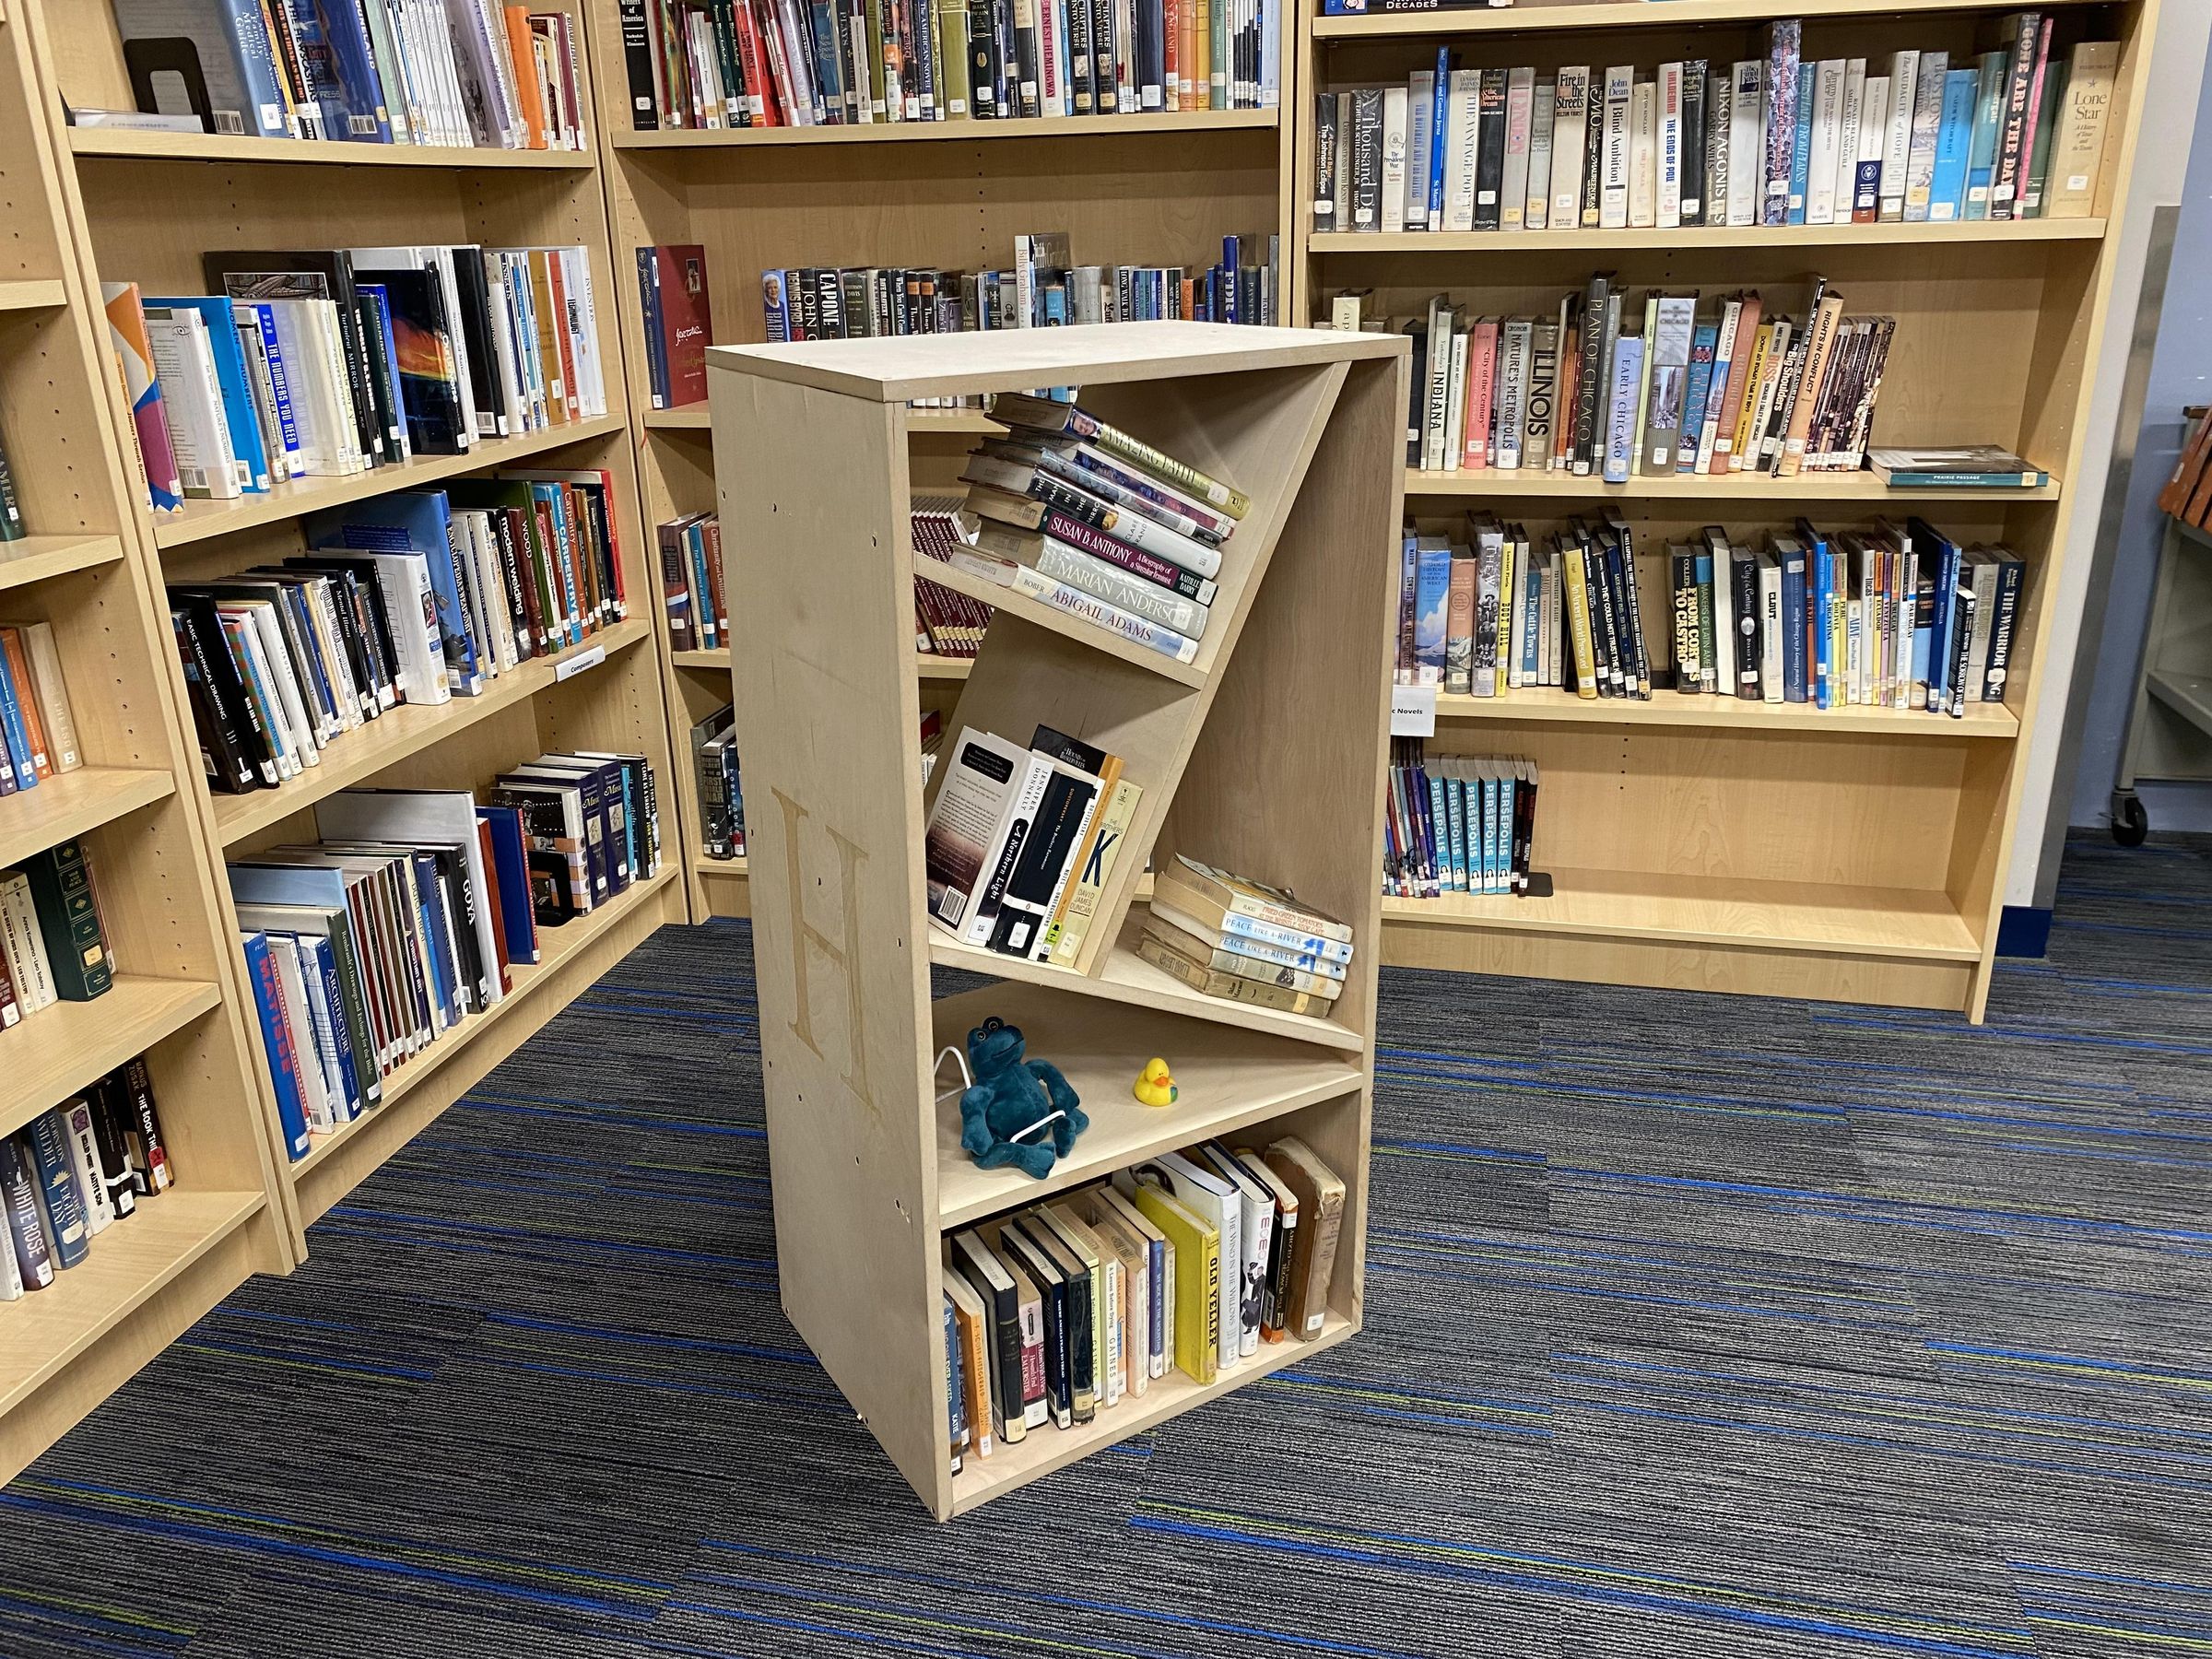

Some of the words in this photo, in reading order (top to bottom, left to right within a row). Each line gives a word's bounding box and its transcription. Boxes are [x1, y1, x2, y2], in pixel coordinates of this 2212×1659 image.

[235, 17, 248, 54] Guide
[242, 11, 258, 60] Medical
[921, 16, 930, 61] AMERICAN
[2016, 27, 2034, 74] GONE
[923, 63, 931, 92] NOVEL
[1043, 45, 1055, 98] HEMINGWAY
[1559, 74, 1577, 87] Fire
[1577, 73, 1585, 85] in
[1609, 79, 1628, 89] John
[1556, 96, 1584, 109] Streets
[1571, 85, 1583, 97] the
[1608, 88, 1629, 97] Dean
[1718, 80, 1731, 132] NIXON
[1898, 70, 1910, 118] AUDACITY
[2011, 77, 2028, 112] ARE
[2074, 92, 2108, 105] Lone
[1612, 107, 1624, 134] Blind
[1896, 122, 1904, 130] of
[2075, 106, 2101, 121] Star
[1360, 113, 1380, 186] Thousand
[1894, 132, 1903, 159] HOPE
[2006, 117, 2021, 154] THE
[1320, 140, 1328, 169] Johnson
[1610, 135, 1622, 182] Ambition
[1707, 143, 1715, 170] WILLS
[1714, 137, 1728, 224] AGONISS
[1018, 249, 1028, 269] Billy
[501, 262, 512, 300] INSECTS
[819, 273, 839, 325] CAPONE
[896, 276, 904, 293] When
[1018, 269, 1028, 306] Graham
[801, 289, 817, 327] JOHN
[897, 304, 905, 318] Can't
[1587, 300, 1603, 339] PLAN
[1818, 311, 1832, 342] RIGHTS
[227, 306, 240, 345] WOMEN
[239, 363, 254, 411] NUMBERS
[266, 343, 279, 358] THE
[340, 312, 352, 349] Turbulent
[348, 353, 359, 389] MIRROR
[1508, 334, 1522, 382] NATURE'S
[1585, 342, 1599, 365] OF
[1784, 351, 1797, 367] Big
[1816, 342, 1824, 352] IN
[270, 362, 288, 401] NUMBERS
[1619, 359, 1630, 396] EARLY
[1773, 367, 1793, 412] Shoulders
[1806, 353, 1821, 394] CONFLICT
[1430, 371, 1444, 430] INDIANA
[1527, 349, 1556, 436] ILLINOIS
[1579, 367, 1596, 441] CHICAGO
[280, 404, 293, 420] YOU
[1501, 385, 1518, 449] METROPOLIS
[1613, 402, 1626, 458] CHICAGO
[284, 423, 297, 444] NEED
[556, 495, 564, 524] MODERN
[563, 492, 576, 545] Carpentry
[522, 520, 533, 559] WOOD
[1051, 517, 1080, 542] SUSAN
[1082, 531, 1090, 547] B.
[1090, 535, 1133, 563] ANTHONY
[501, 516, 516, 567] modern
[509, 567, 524, 616] welding
[559, 525, 577, 610] CARPENTRY
[1057, 561, 1114, 597] MARIAN
[1116, 588, 1193, 627] ANDERSO
[1529, 596, 1537, 612] The
[1601, 586, 1609, 602] THEY
[1676, 588, 1688, 608] TO
[1768, 592, 1776, 619] CLOUT
[1865, 578, 1874, 596] Incas
[2004, 591, 2014, 614] THE
[335, 590, 346, 615] Mental
[341, 616, 352, 638] Illness
[1023, 579, 1045, 593] BOBER
[1050, 589, 1103, 621] ABIGAIL
[1106, 615, 1154, 641] ADAMS
[1500, 602, 1510, 623] BOOT
[1527, 612, 1536, 633] Cattle
[1603, 603, 1612, 624] COULD
[1687, 587, 1699, 627] FROM
[1701, 616, 1709, 627] OF
[1500, 627, 1510, 646] HILL
[1526, 634, 1535, 658] Towns
[1608, 636, 1617, 655] TRUST
[1676, 610, 1688, 664] CASTRO
[1701, 627, 1711, 648] LATIN
[1994, 615, 2011, 666] WARRIOR
[185, 618, 200, 641] BASIC
[194, 642, 215, 684] TECHNICAL
[209, 685, 228, 721] DRAWING
[1610, 655, 1618, 667] THE
[1687, 629, 1700, 682] CORTS
[1397, 707, 1423, 715] Novels
[1020, 767, 1041, 811] DONNELLY
[1029, 771, 1049, 811] JENNIFER
[1014, 825, 1022, 837] A
[1432, 782, 1445, 853] PERSEPOLIS
[1449, 784, 1461, 855] PERSEPOLIS
[1466, 786, 1477, 857] PERSEPOLIS
[1486, 785, 1494, 856] PERSEPOLIS
[1500, 784, 1510, 856] PERSEPOLIS
[999, 836, 1021, 875] Northern
[1081, 829, 1119, 888] K
[462, 878, 477, 925] GOYA
[990, 874, 1004, 900] Light
[1074, 897, 1092, 907] JAMES
[1077, 888, 1095, 900] DAVID
[1219, 935, 1245, 949] PEACE
[1247, 945, 1262, 953] LIKE
[1270, 949, 1295, 962] RIVER
[1226, 918, 1253, 932] PEACE
[1254, 928, 1269, 936] LIKE
[1277, 932, 1301, 946] RIVER
[258, 958, 290, 1075] MATISSE
[327, 967, 351, 1055] ARCHITECTURE
[365, 1058, 373, 1076] Bible
[138, 1093, 147, 1111] THE
[47, 1114, 65, 1163] THORNTON
[142, 1110, 154, 1134] BOOK
[37, 1118, 56, 1169] WILDER
[13, 1179, 38, 1219] WHITE
[21, 1219, 45, 1258] ROSE
[1209, 1257, 1218, 1287] OLD
[1230, 1261, 1237, 1270] IN
[1208, 1291, 1218, 1348] YELLER
[1229, 1286, 1237, 1325] WILLOWS
